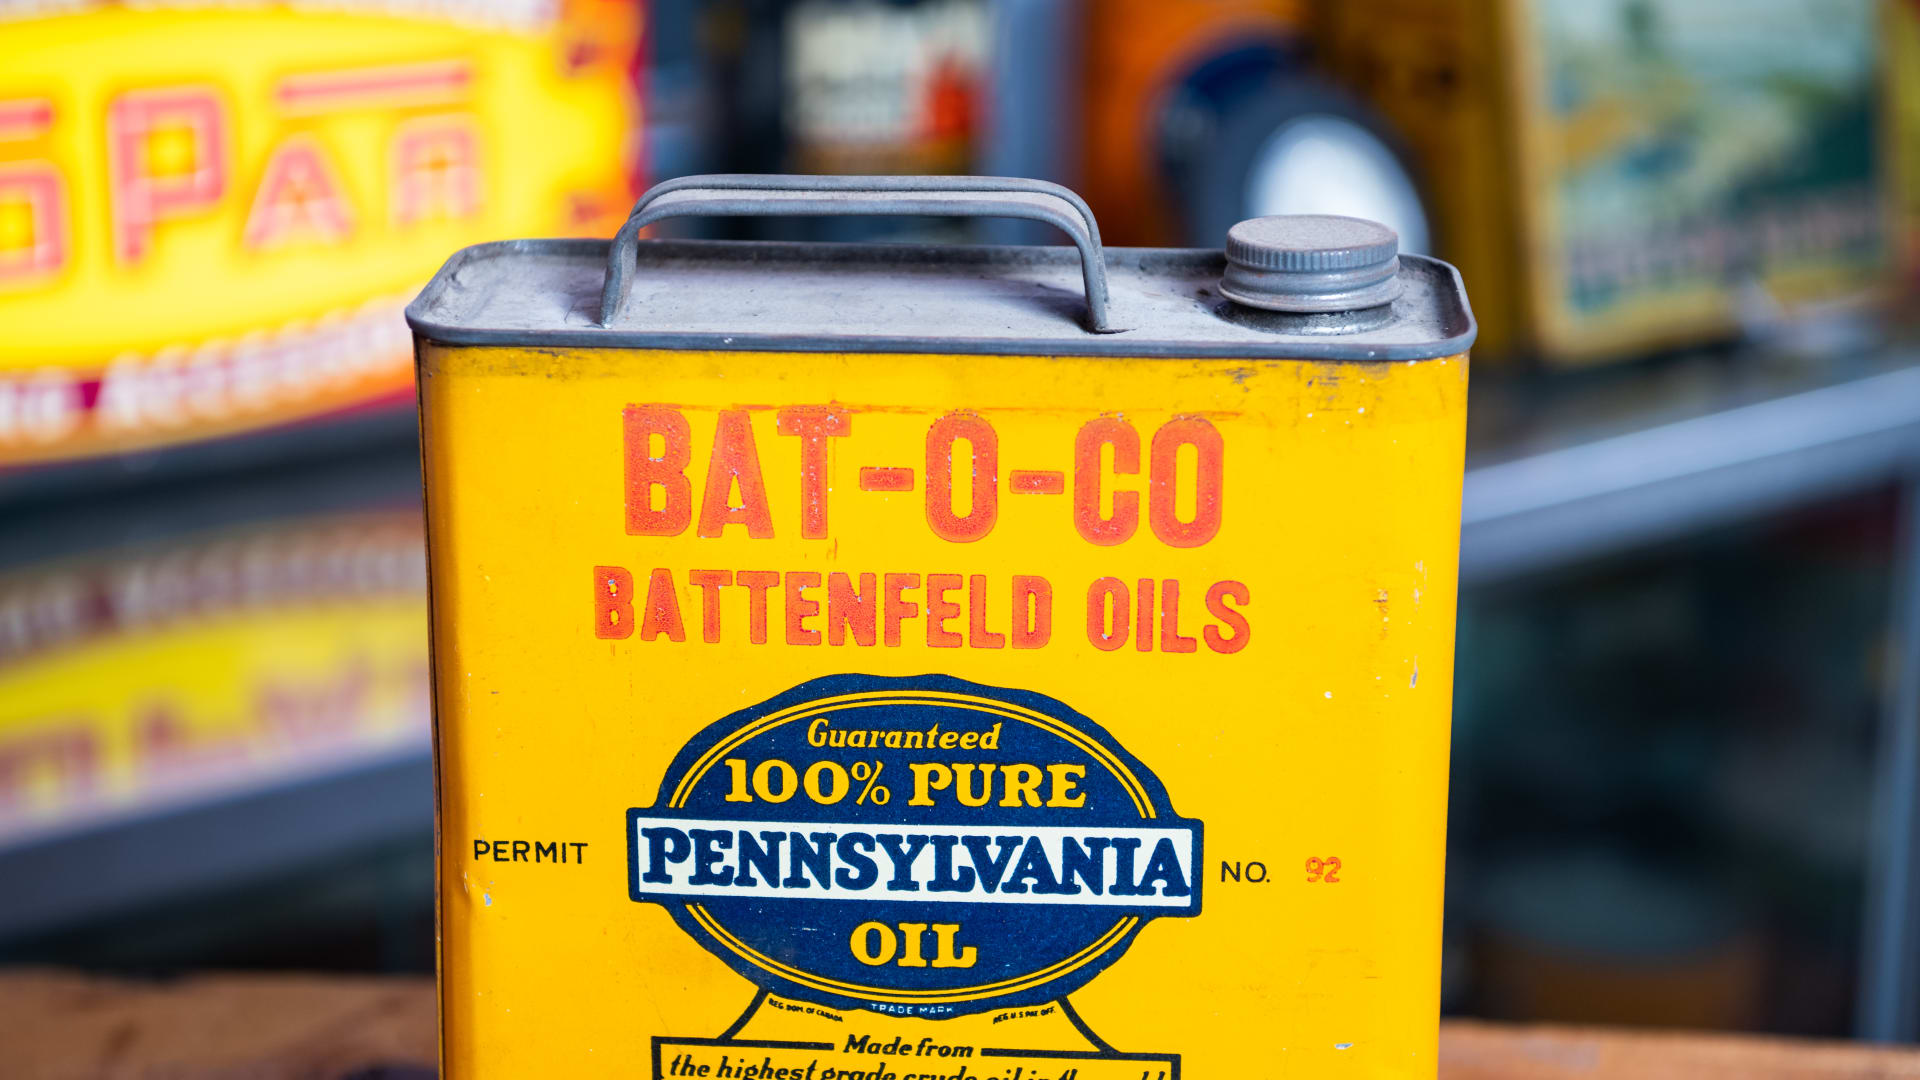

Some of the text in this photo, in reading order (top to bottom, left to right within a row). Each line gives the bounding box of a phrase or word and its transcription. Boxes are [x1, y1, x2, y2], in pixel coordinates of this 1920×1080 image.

[622, 405, 1224, 549] BAT-O-CO
[593, 565, 1251, 654] BATTENFELD OILS
[806, 718, 1003, 752] Guaranteed
[724, 758, 1088, 809] 100% PURE
[473, 839, 589, 865] PERMIT
[641, 825, 1193, 898] PENNSYLVANIA
[1220, 856, 1342, 883] NO. 92
[849, 921, 978, 969] OIL
[871, 1003, 954, 1015] TRADE MARK
[842, 1033, 975, 1058] Made from
[669, 1054, 711, 1078] the
[716, 1055, 818, 1080] highest
[820, 1061, 897, 1080] grade
